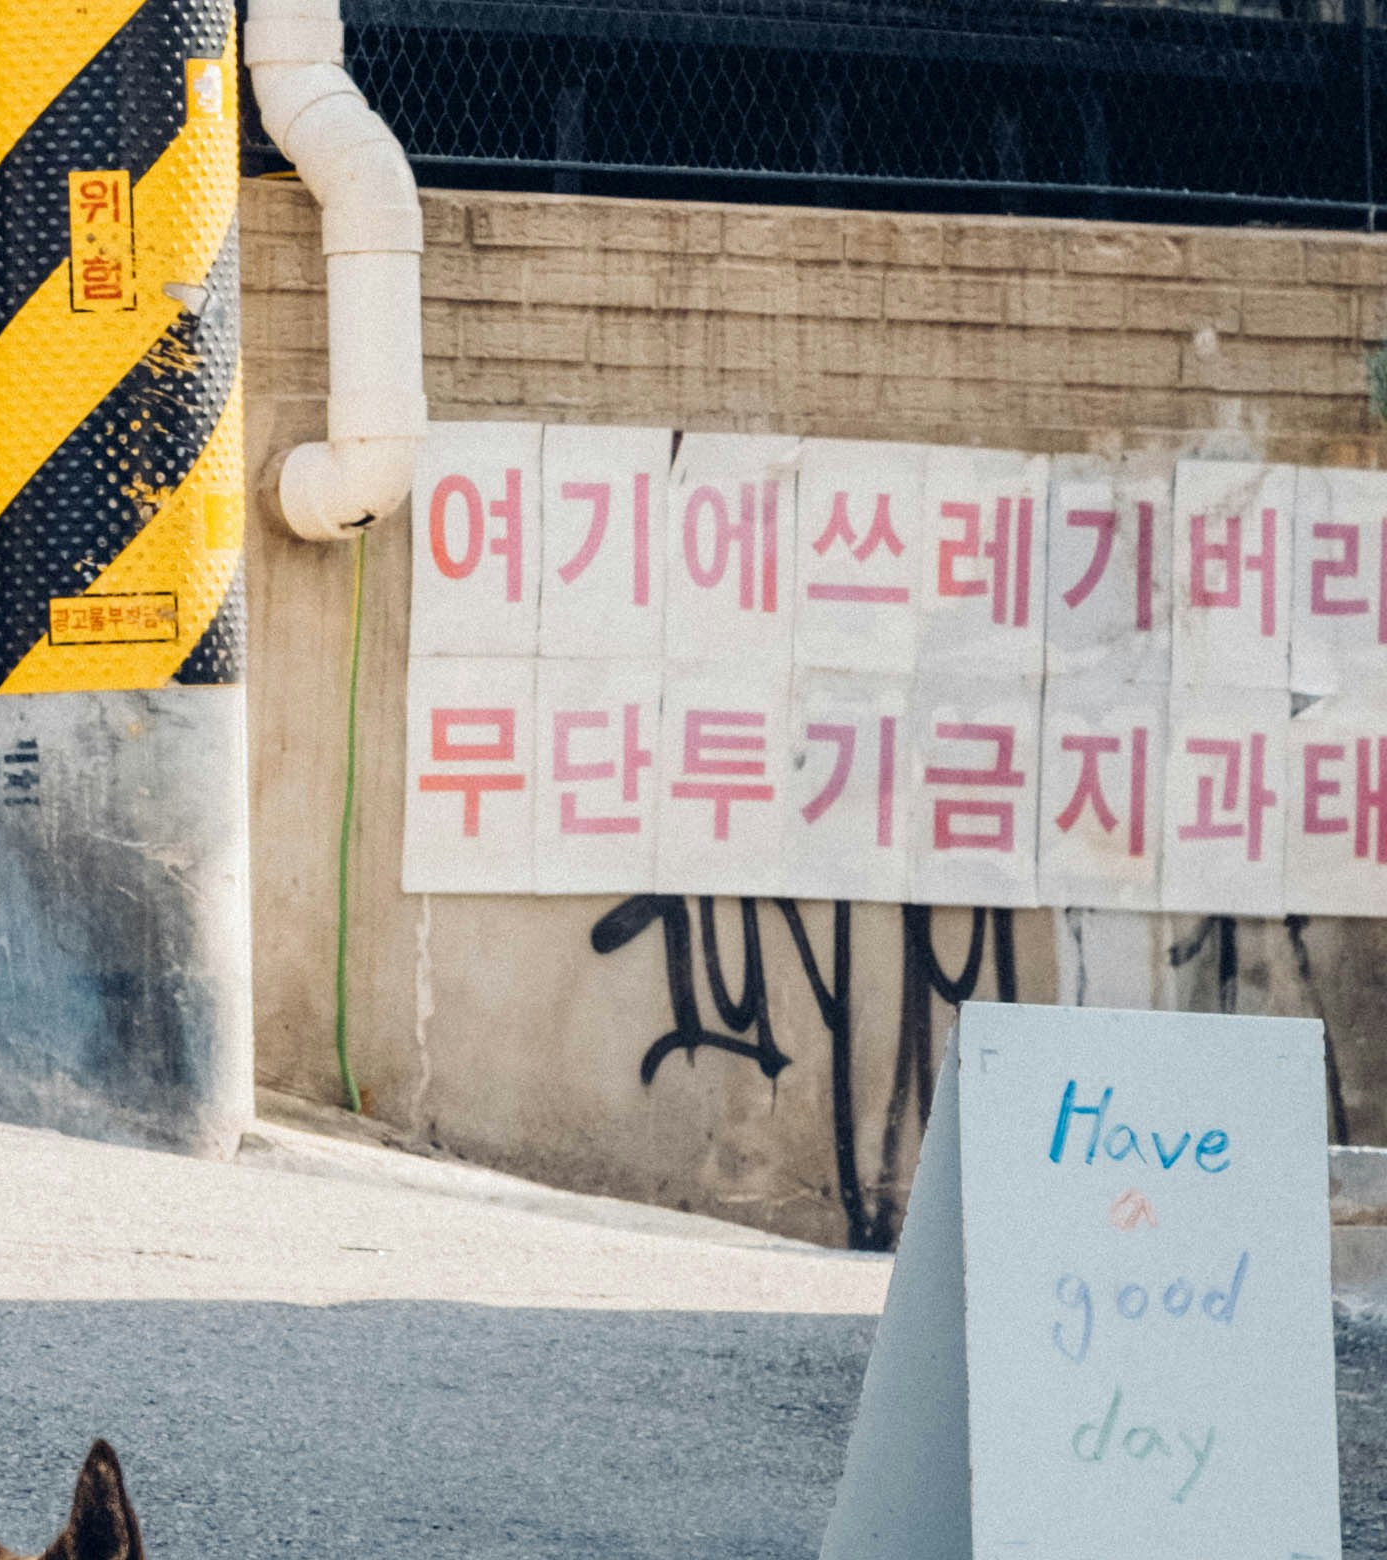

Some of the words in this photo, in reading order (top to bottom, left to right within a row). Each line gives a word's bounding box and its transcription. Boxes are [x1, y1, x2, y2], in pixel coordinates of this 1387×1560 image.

[1049, 1079, 1231, 1174] Have
[1109, 1185, 1159, 1232] a
[1051, 1250, 1250, 1365] good
[1071, 1382, 1218, 1505] day
